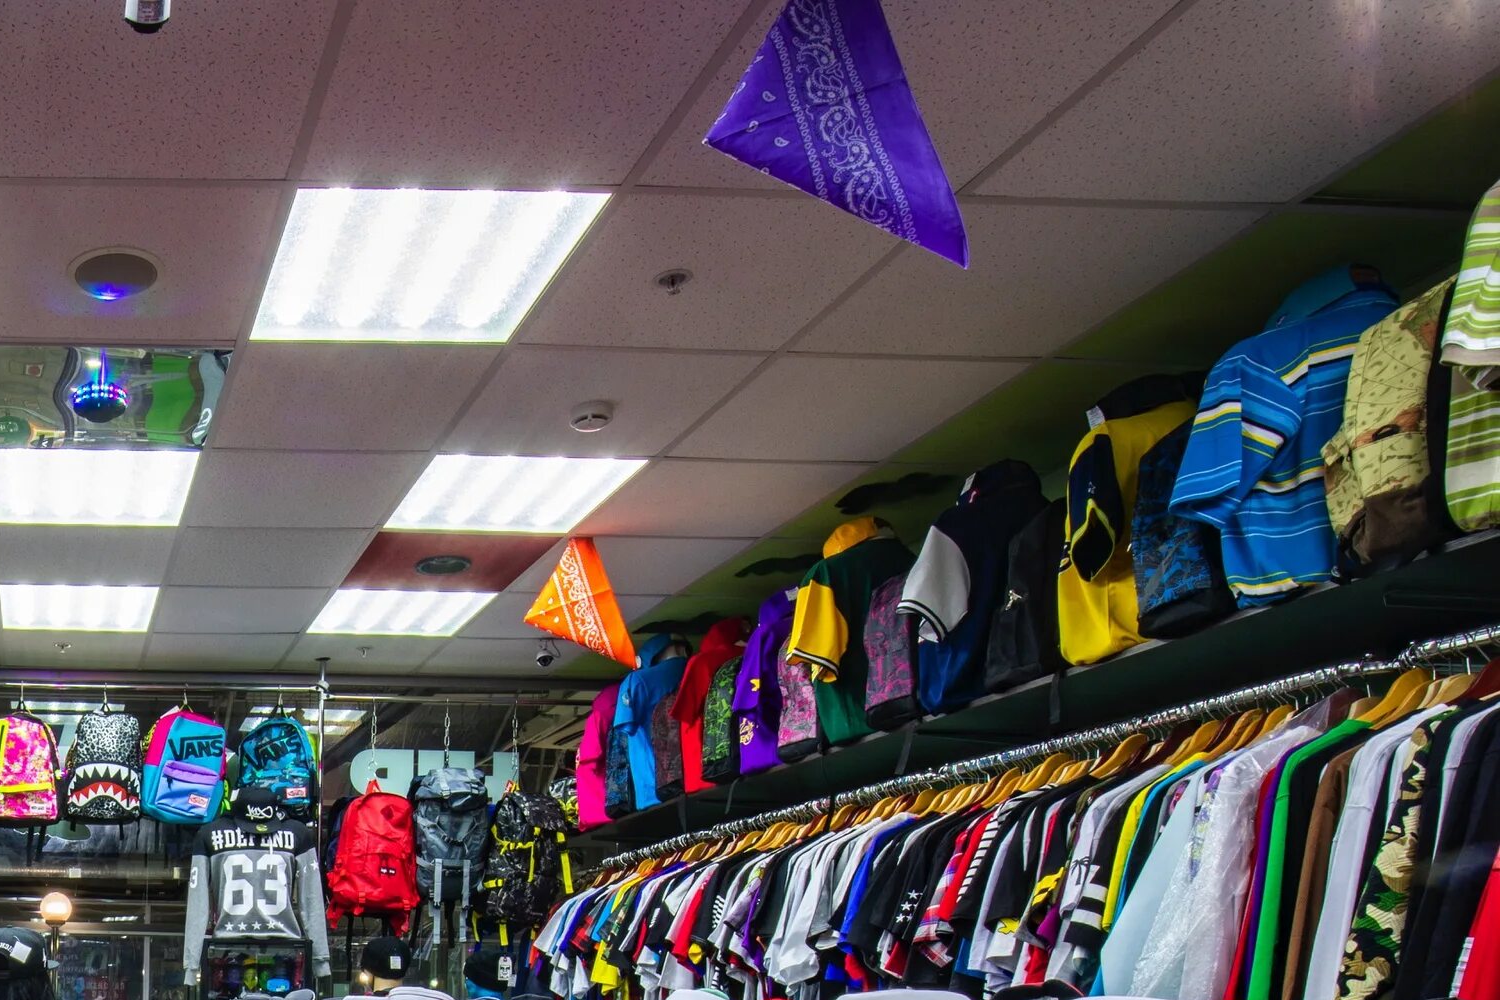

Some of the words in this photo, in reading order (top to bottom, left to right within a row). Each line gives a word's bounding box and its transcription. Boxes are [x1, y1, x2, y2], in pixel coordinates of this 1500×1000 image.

[168, 733, 224, 761] VANS
[244, 731, 302, 770] VANS
[223, 854, 288, 916] 63
